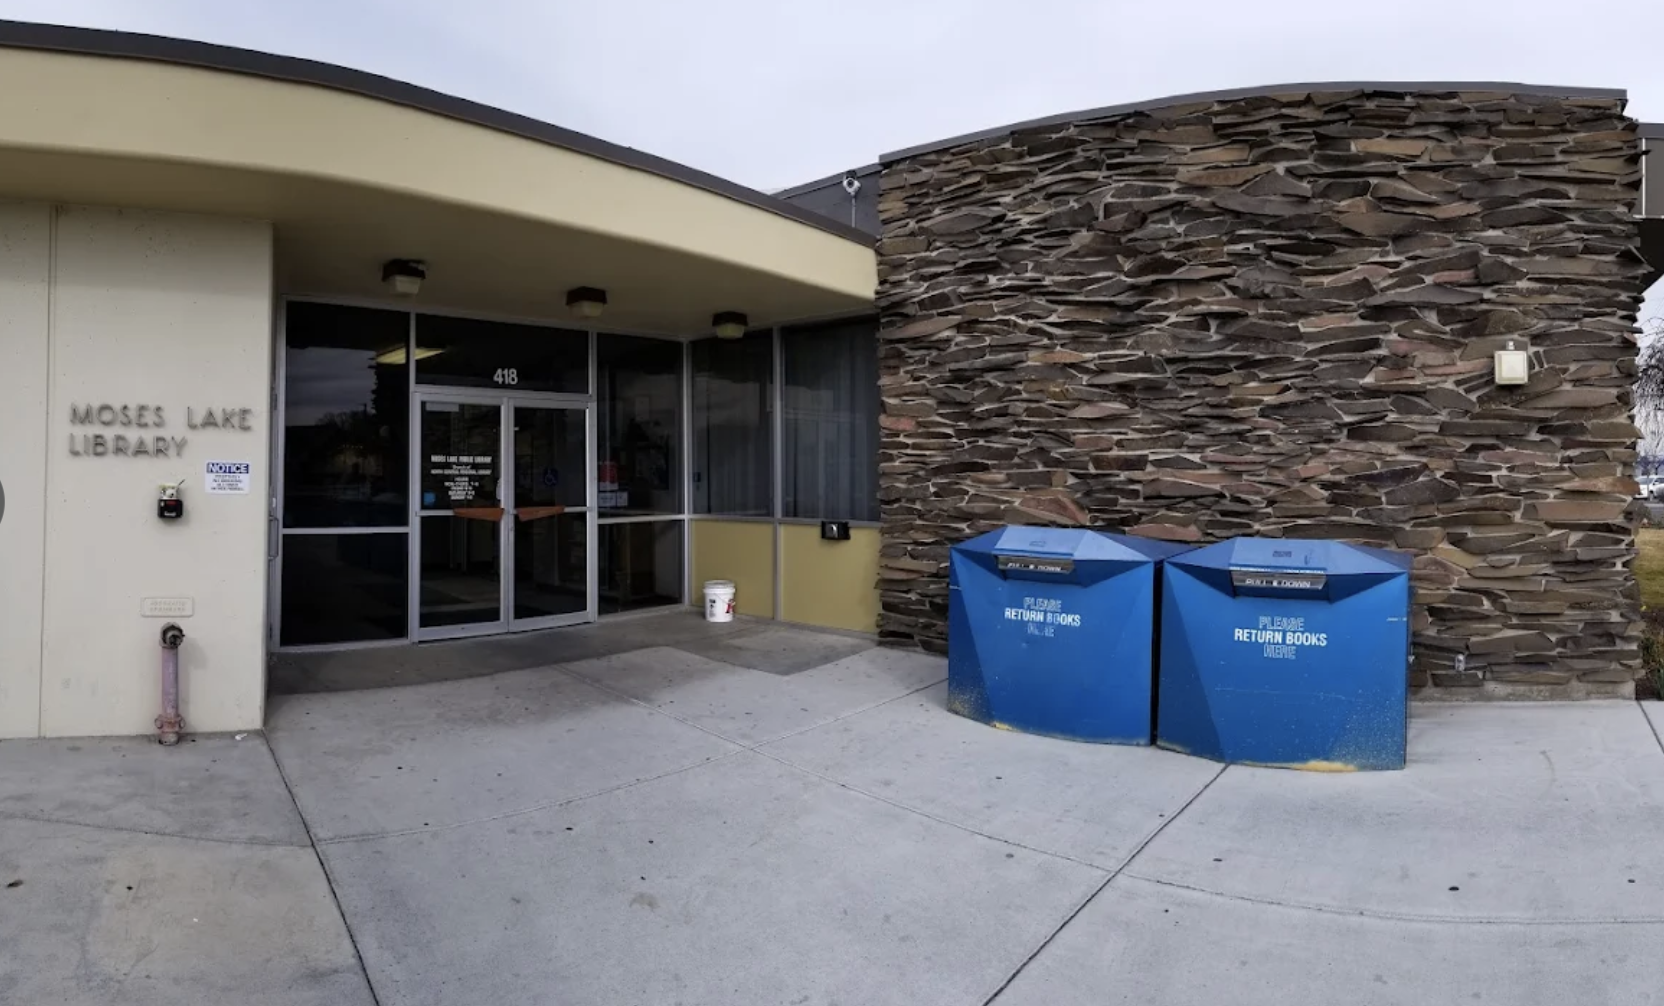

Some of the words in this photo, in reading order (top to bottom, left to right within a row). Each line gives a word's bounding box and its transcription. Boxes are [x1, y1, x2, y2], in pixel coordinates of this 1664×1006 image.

[493, 367, 519, 385] 418
[70, 403, 166, 428] MOSES
[186, 406, 253, 431] LAKE
[69, 432, 189, 458] LIBRARY
[209, 463, 248, 473] NOTICE
[1280, 580, 1311, 588] DOWN
[1023, 597, 1062, 612] PLEASE
[1004, 607, 1044, 622] RETURN
[1046, 612, 1081, 627] BOOKS
[1259, 615, 1304, 631] PLEASE
[1234, 628, 1283, 644] RETURN
[1285, 632, 1328, 647] BOOKS
[1263, 643, 1297, 660] HERE
